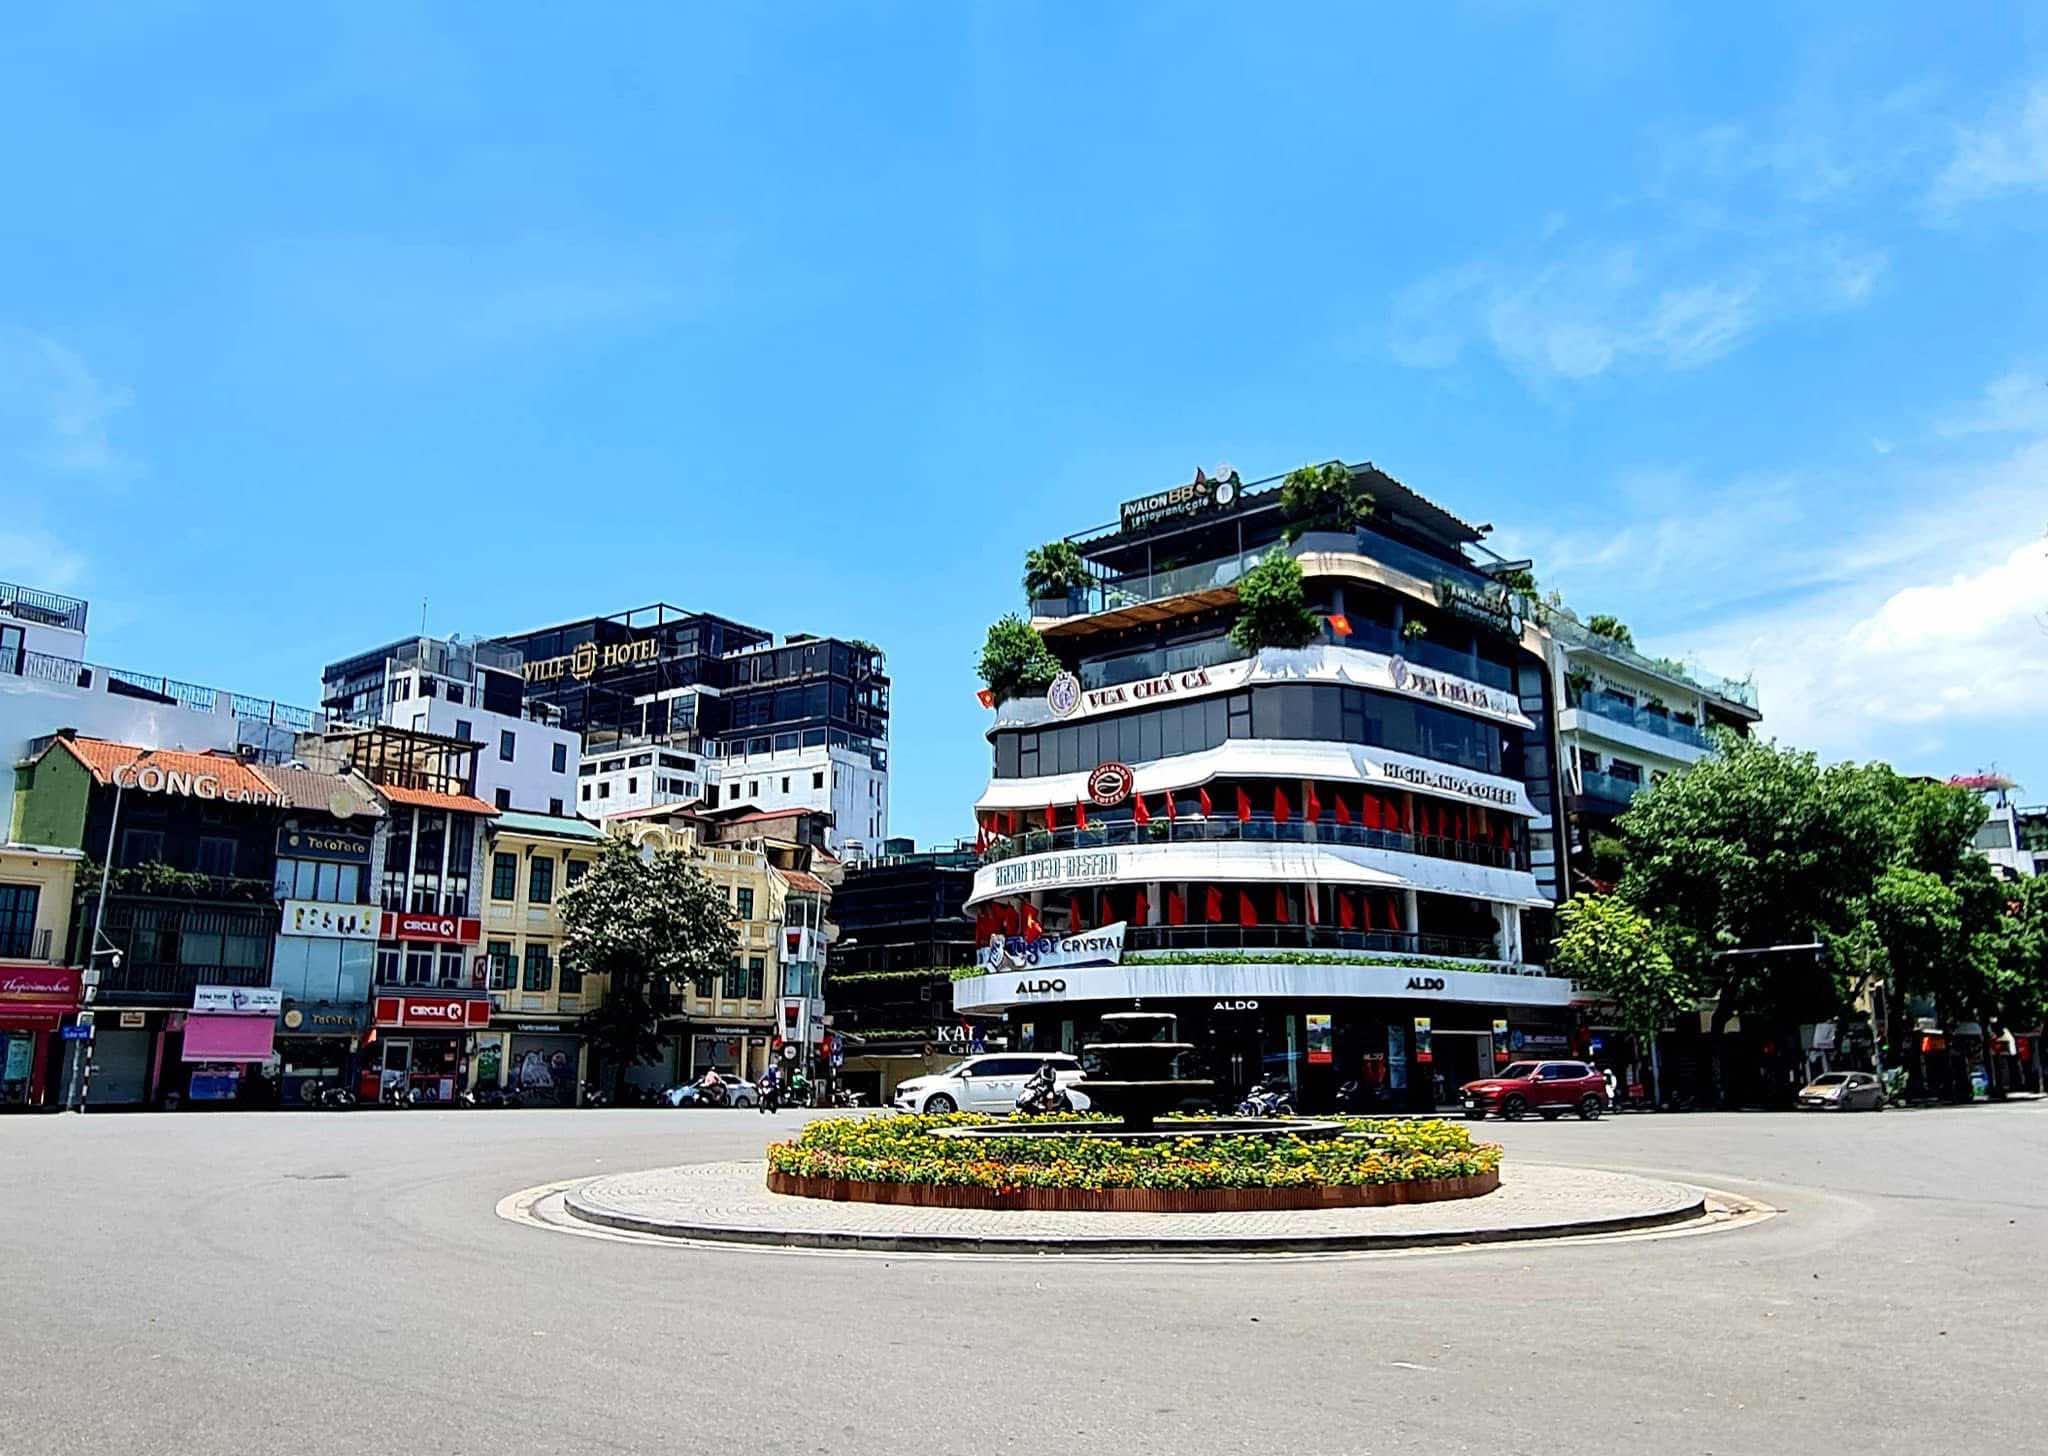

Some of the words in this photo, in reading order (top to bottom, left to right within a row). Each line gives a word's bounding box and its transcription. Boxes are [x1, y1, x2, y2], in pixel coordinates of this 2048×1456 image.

[1124, 494, 1168, 517] AVALON
[603, 638, 660, 666] HOTEL
[1088, 688, 1128, 708] VUA
[1384, 763, 1467, 794] HIGHLANDS
[1468, 781, 1517, 804] COFFEE
[404, 920, 438, 933] CIRCLE
[440, 920, 454, 936] K
[1006, 936, 1057, 965] Tiger
[1061, 936, 1123, 953] CRYSTAL
[1016, 979, 1066, 994] ALDO
[1405, 977, 1445, 991] ALDO
[410, 1006, 446, 1017] CIRCLE
[447, 1003, 462, 1020] K
[1213, 1001, 1259, 1010] ALDO
